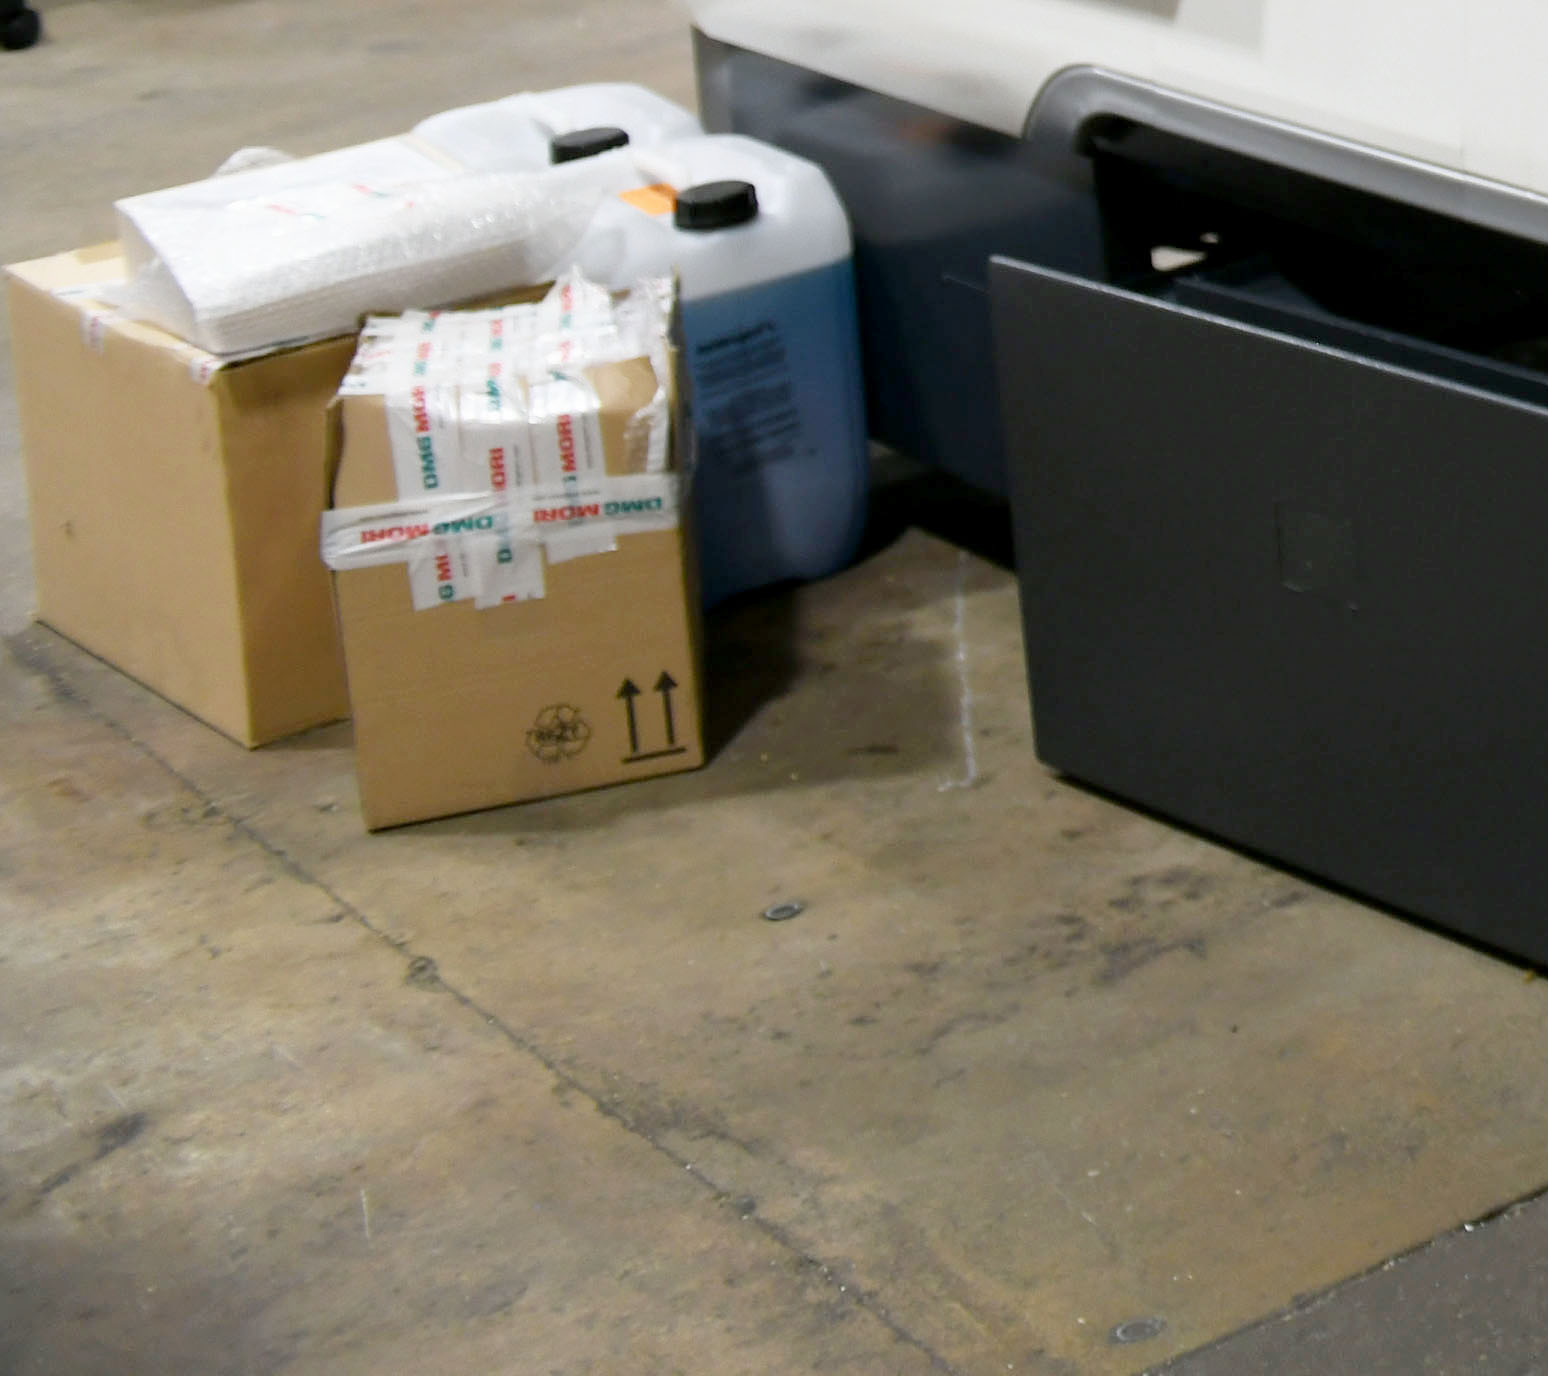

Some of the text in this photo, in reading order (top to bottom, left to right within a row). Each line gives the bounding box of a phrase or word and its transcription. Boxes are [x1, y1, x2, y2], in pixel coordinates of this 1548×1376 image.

[418, 437, 438, 489] DMG
[557, 414, 576, 472] MORI
[491, 448, 507, 490] ORI
[534, 497, 662, 522] DMG MORI
